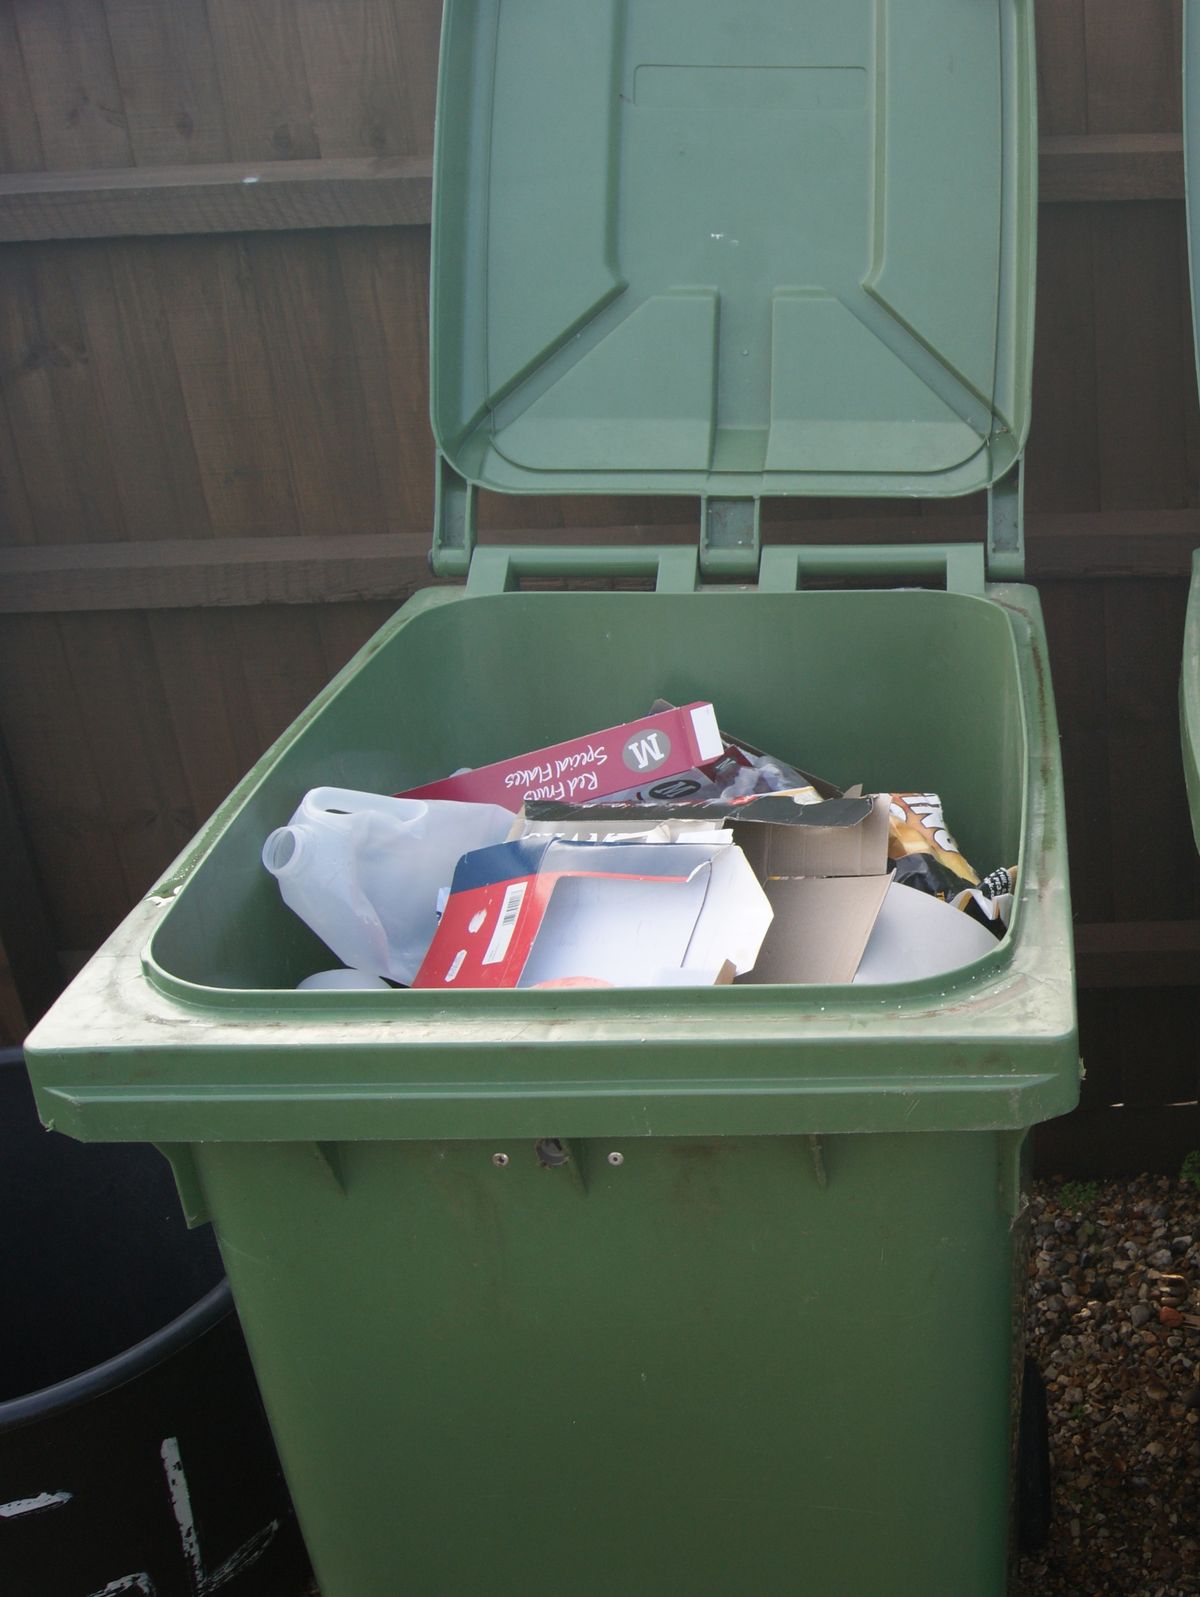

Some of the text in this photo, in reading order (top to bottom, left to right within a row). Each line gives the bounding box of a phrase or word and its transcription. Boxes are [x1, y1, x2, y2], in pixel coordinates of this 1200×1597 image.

[504, 744, 608, 788] Special Flakes
[629, 732, 665, 769] M
[567, 771, 598, 798] Red
[655, 780, 695, 798] M
